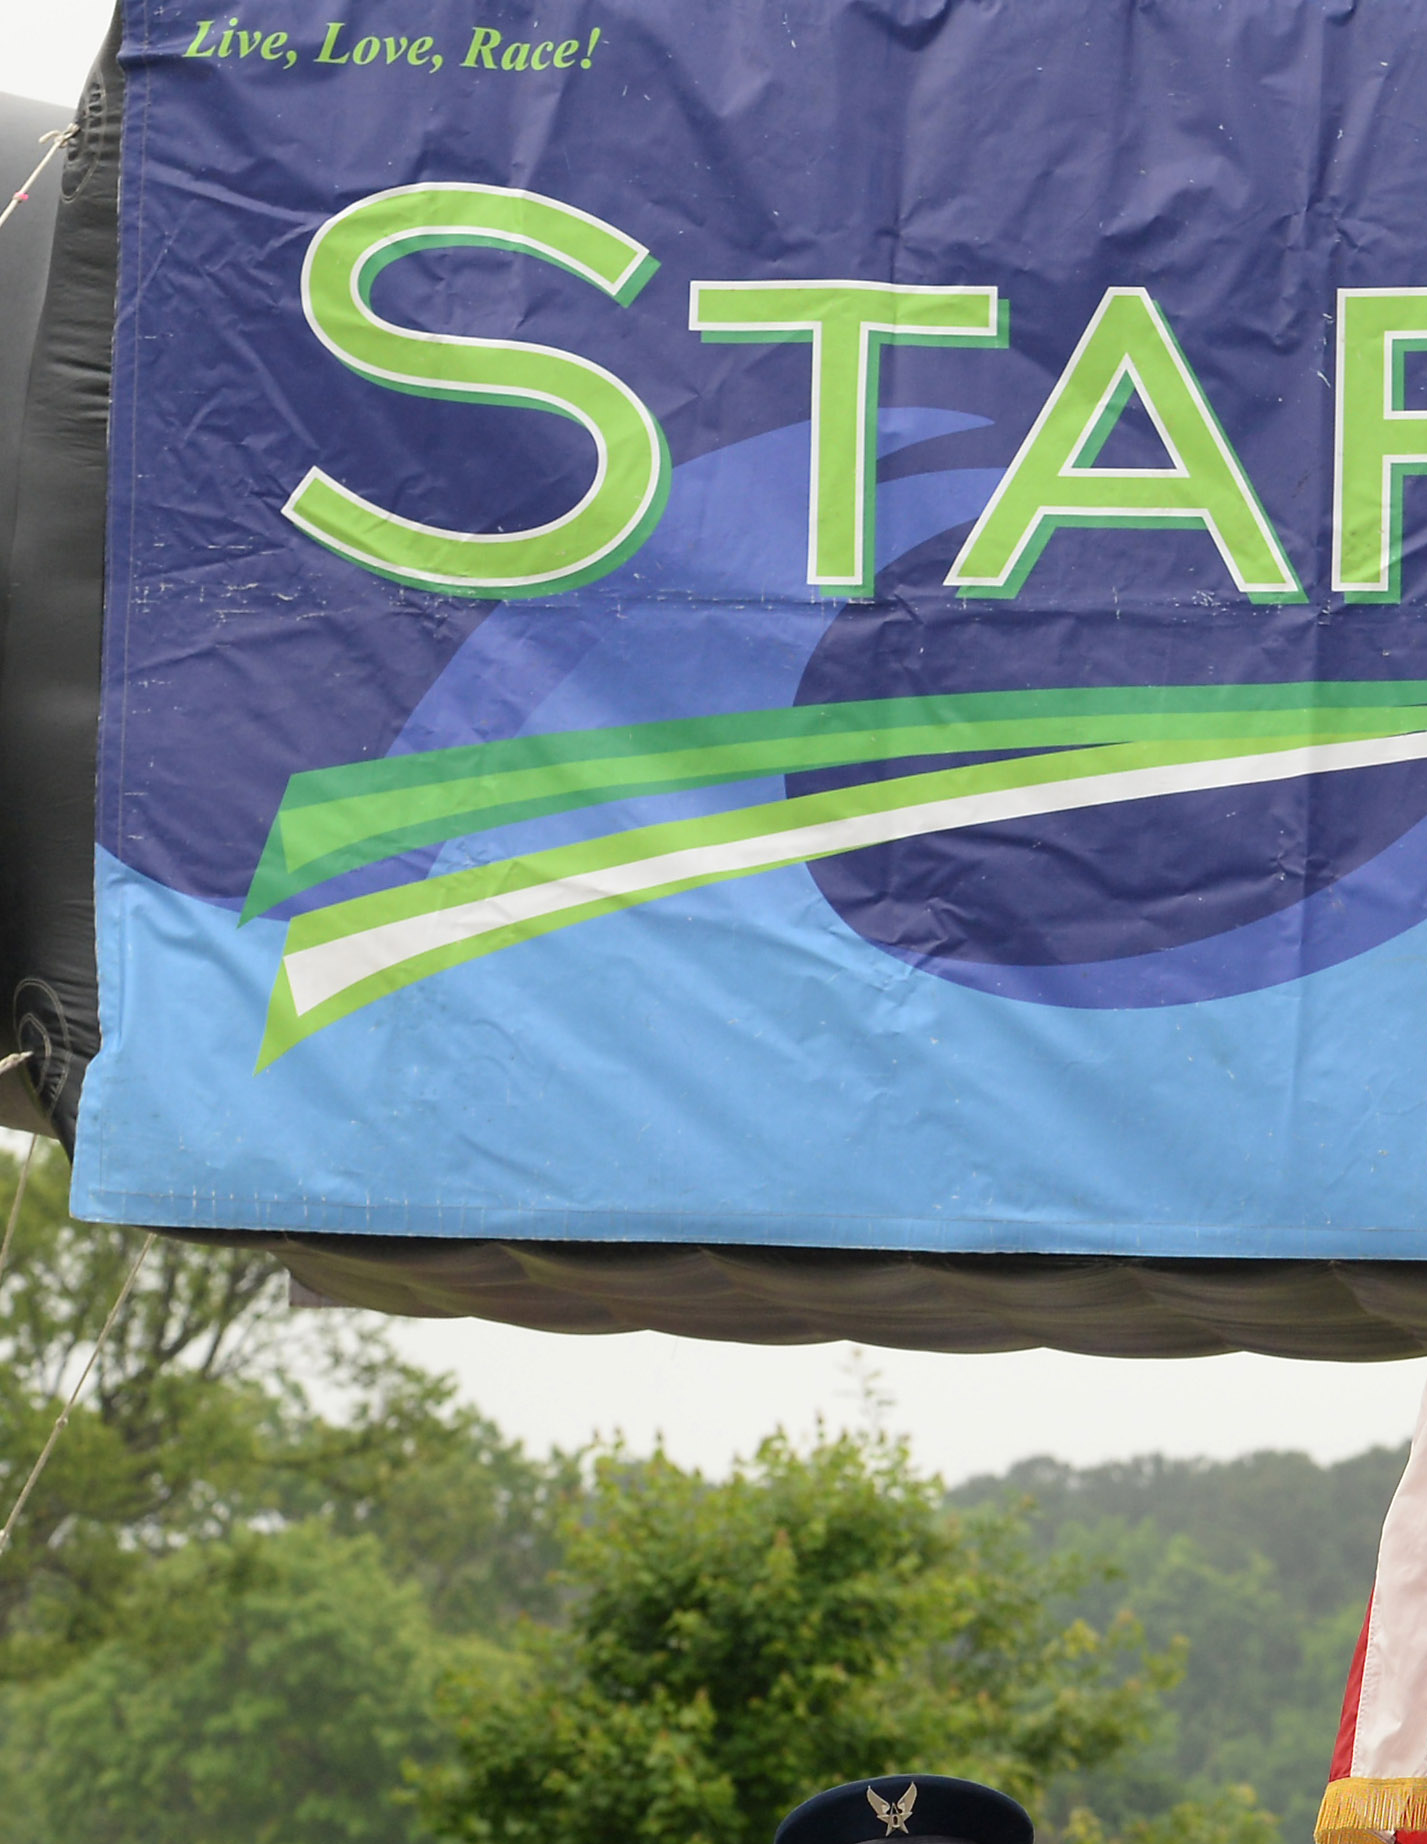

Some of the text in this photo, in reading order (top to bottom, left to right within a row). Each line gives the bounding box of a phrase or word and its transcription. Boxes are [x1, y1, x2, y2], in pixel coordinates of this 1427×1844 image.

[182, 17, 601, 74] Live, Love, Race!
